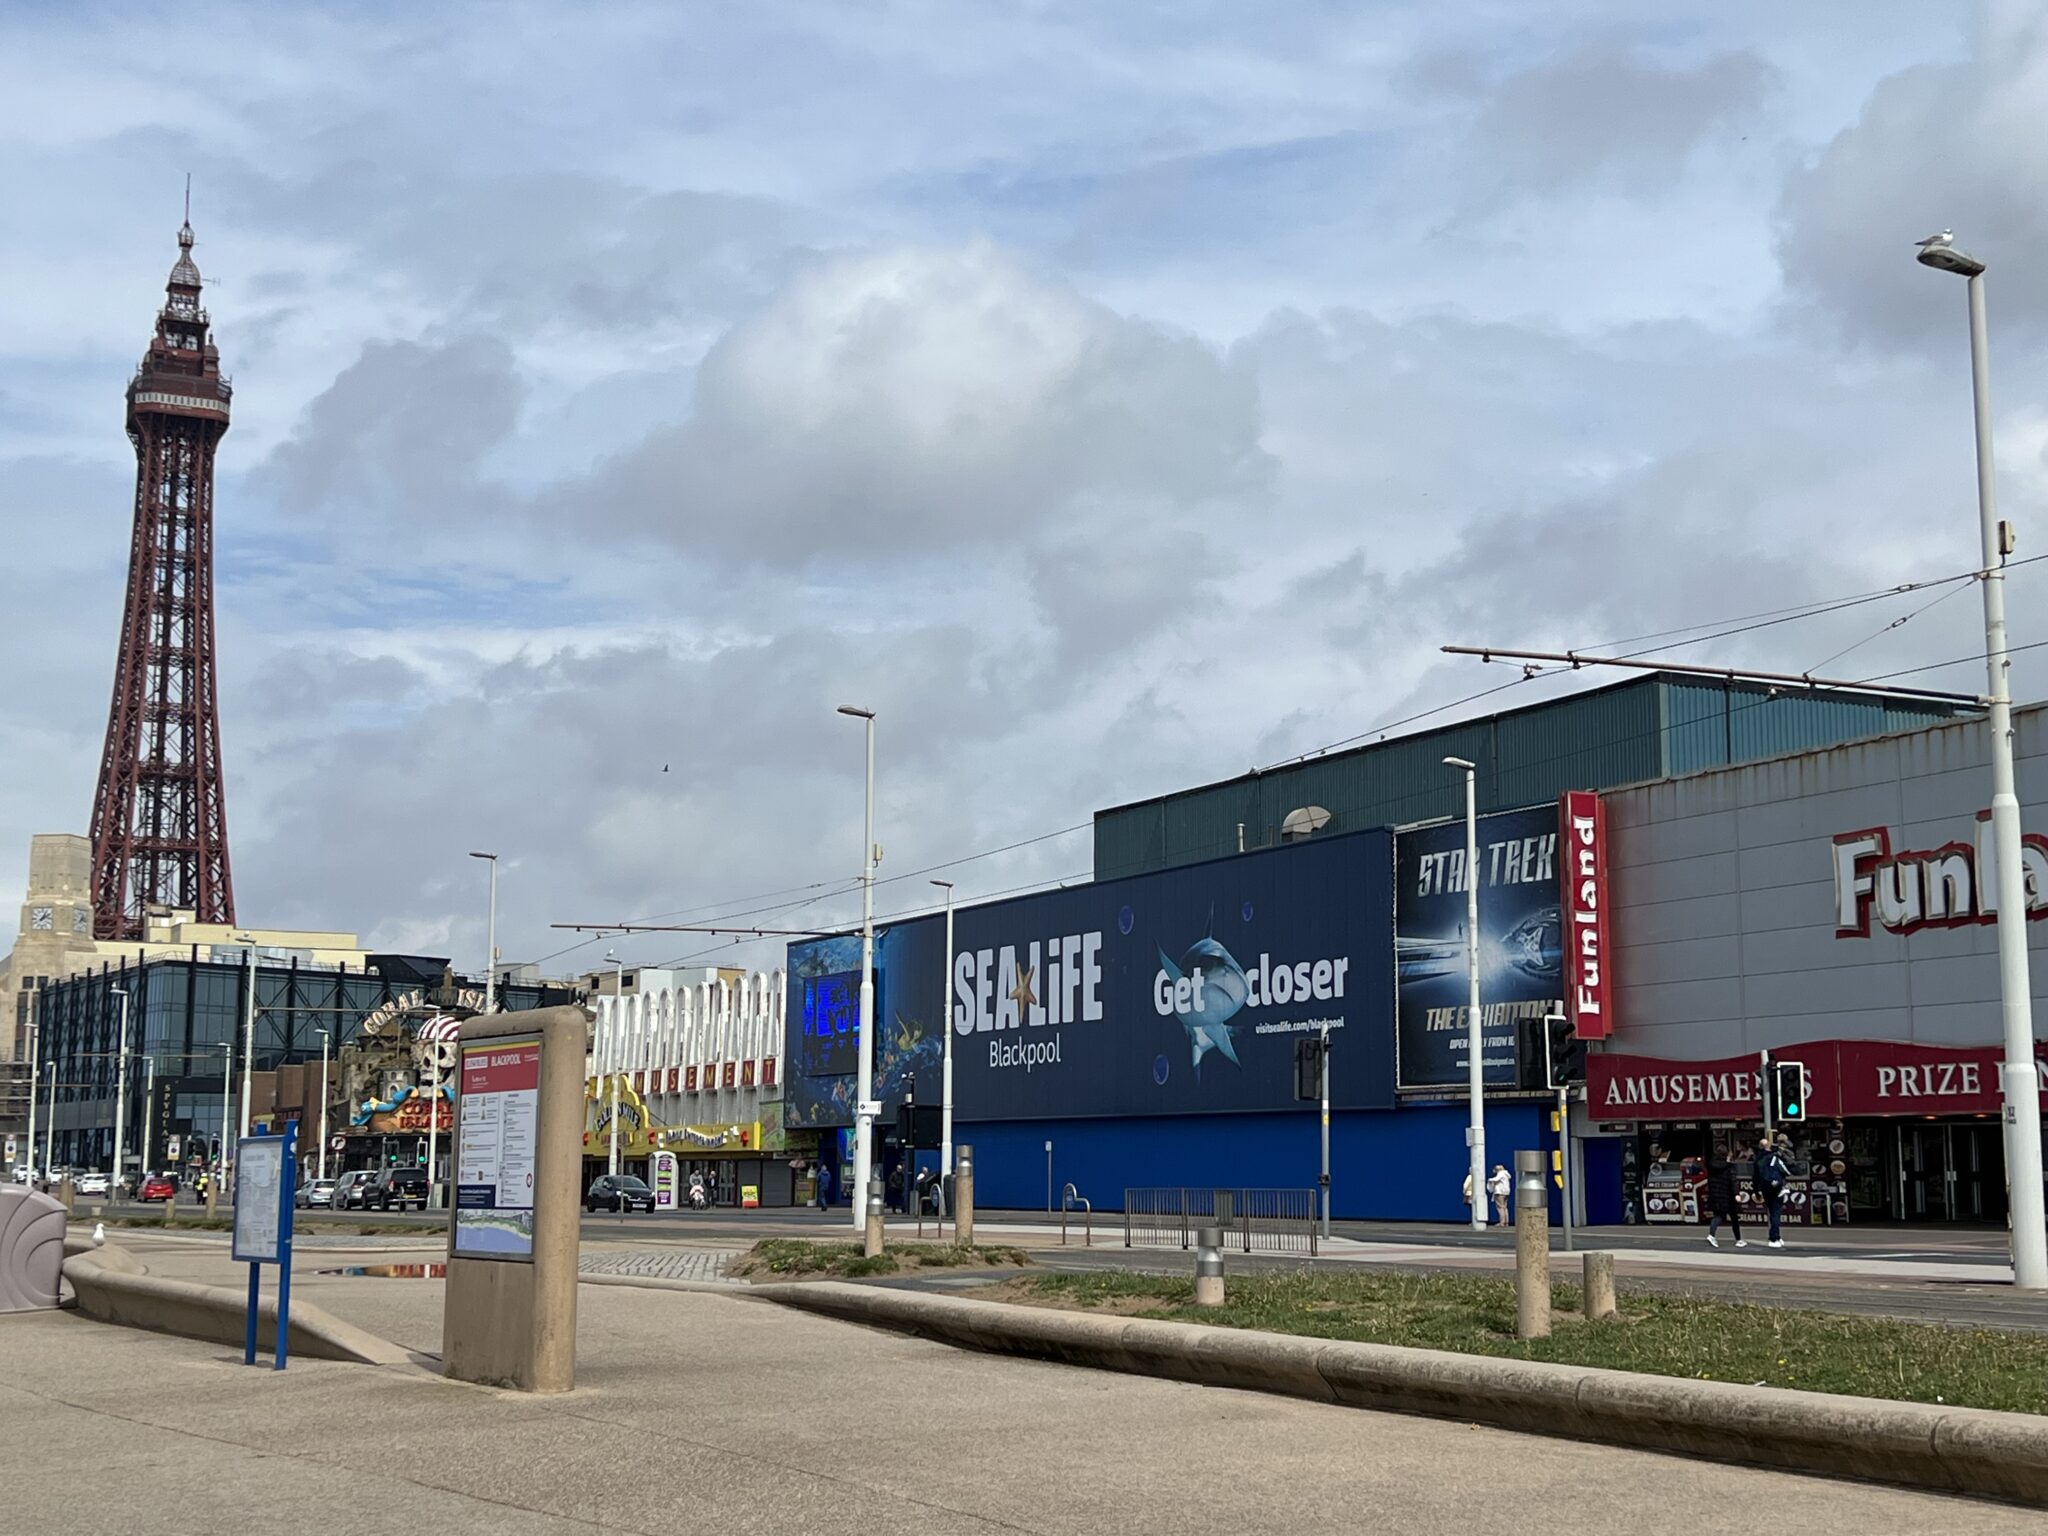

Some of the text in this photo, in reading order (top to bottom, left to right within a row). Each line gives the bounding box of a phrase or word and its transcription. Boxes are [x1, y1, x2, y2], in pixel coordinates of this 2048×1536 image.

[1487, 833, 1556, 887] TREK
[1572, 816, 1600, 1015] Funland
[954, 945, 1019, 1036] SEA
[1154, 952, 1349, 1016] Get closer
[1426, 1007, 1456, 1031] THE
[989, 1032, 1062, 1073] Blackpool
[1876, 1062, 1982, 1098] PRIZE
